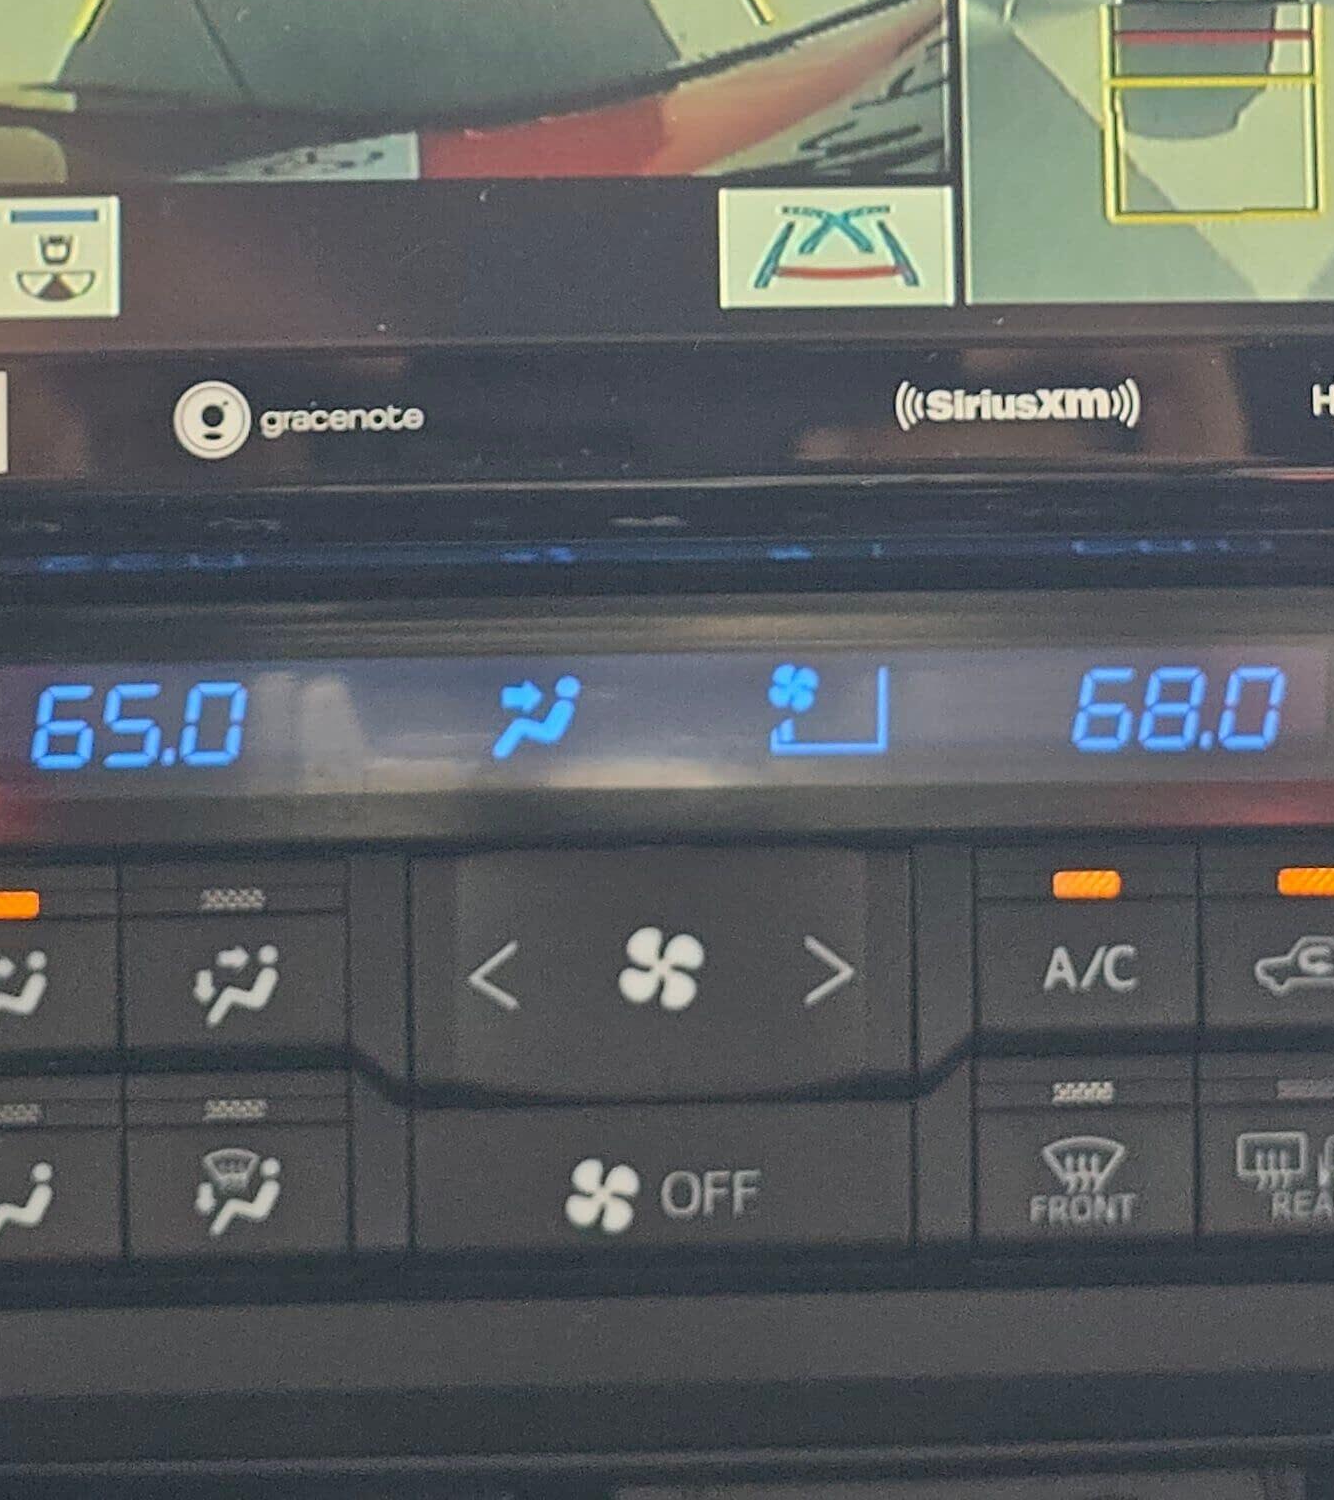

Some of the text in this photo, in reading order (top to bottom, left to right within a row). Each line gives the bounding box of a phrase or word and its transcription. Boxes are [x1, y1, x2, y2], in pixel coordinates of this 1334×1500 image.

[260, 404, 425, 439] gracenote
[30, 682, 248, 770] 65.0
[1071, 666, 1287, 752] 68.0
[1043, 944, 1138, 992] A/C
[660, 1168, 761, 1221] OFF
[1029, 1194, 1136, 1224] FRONT
